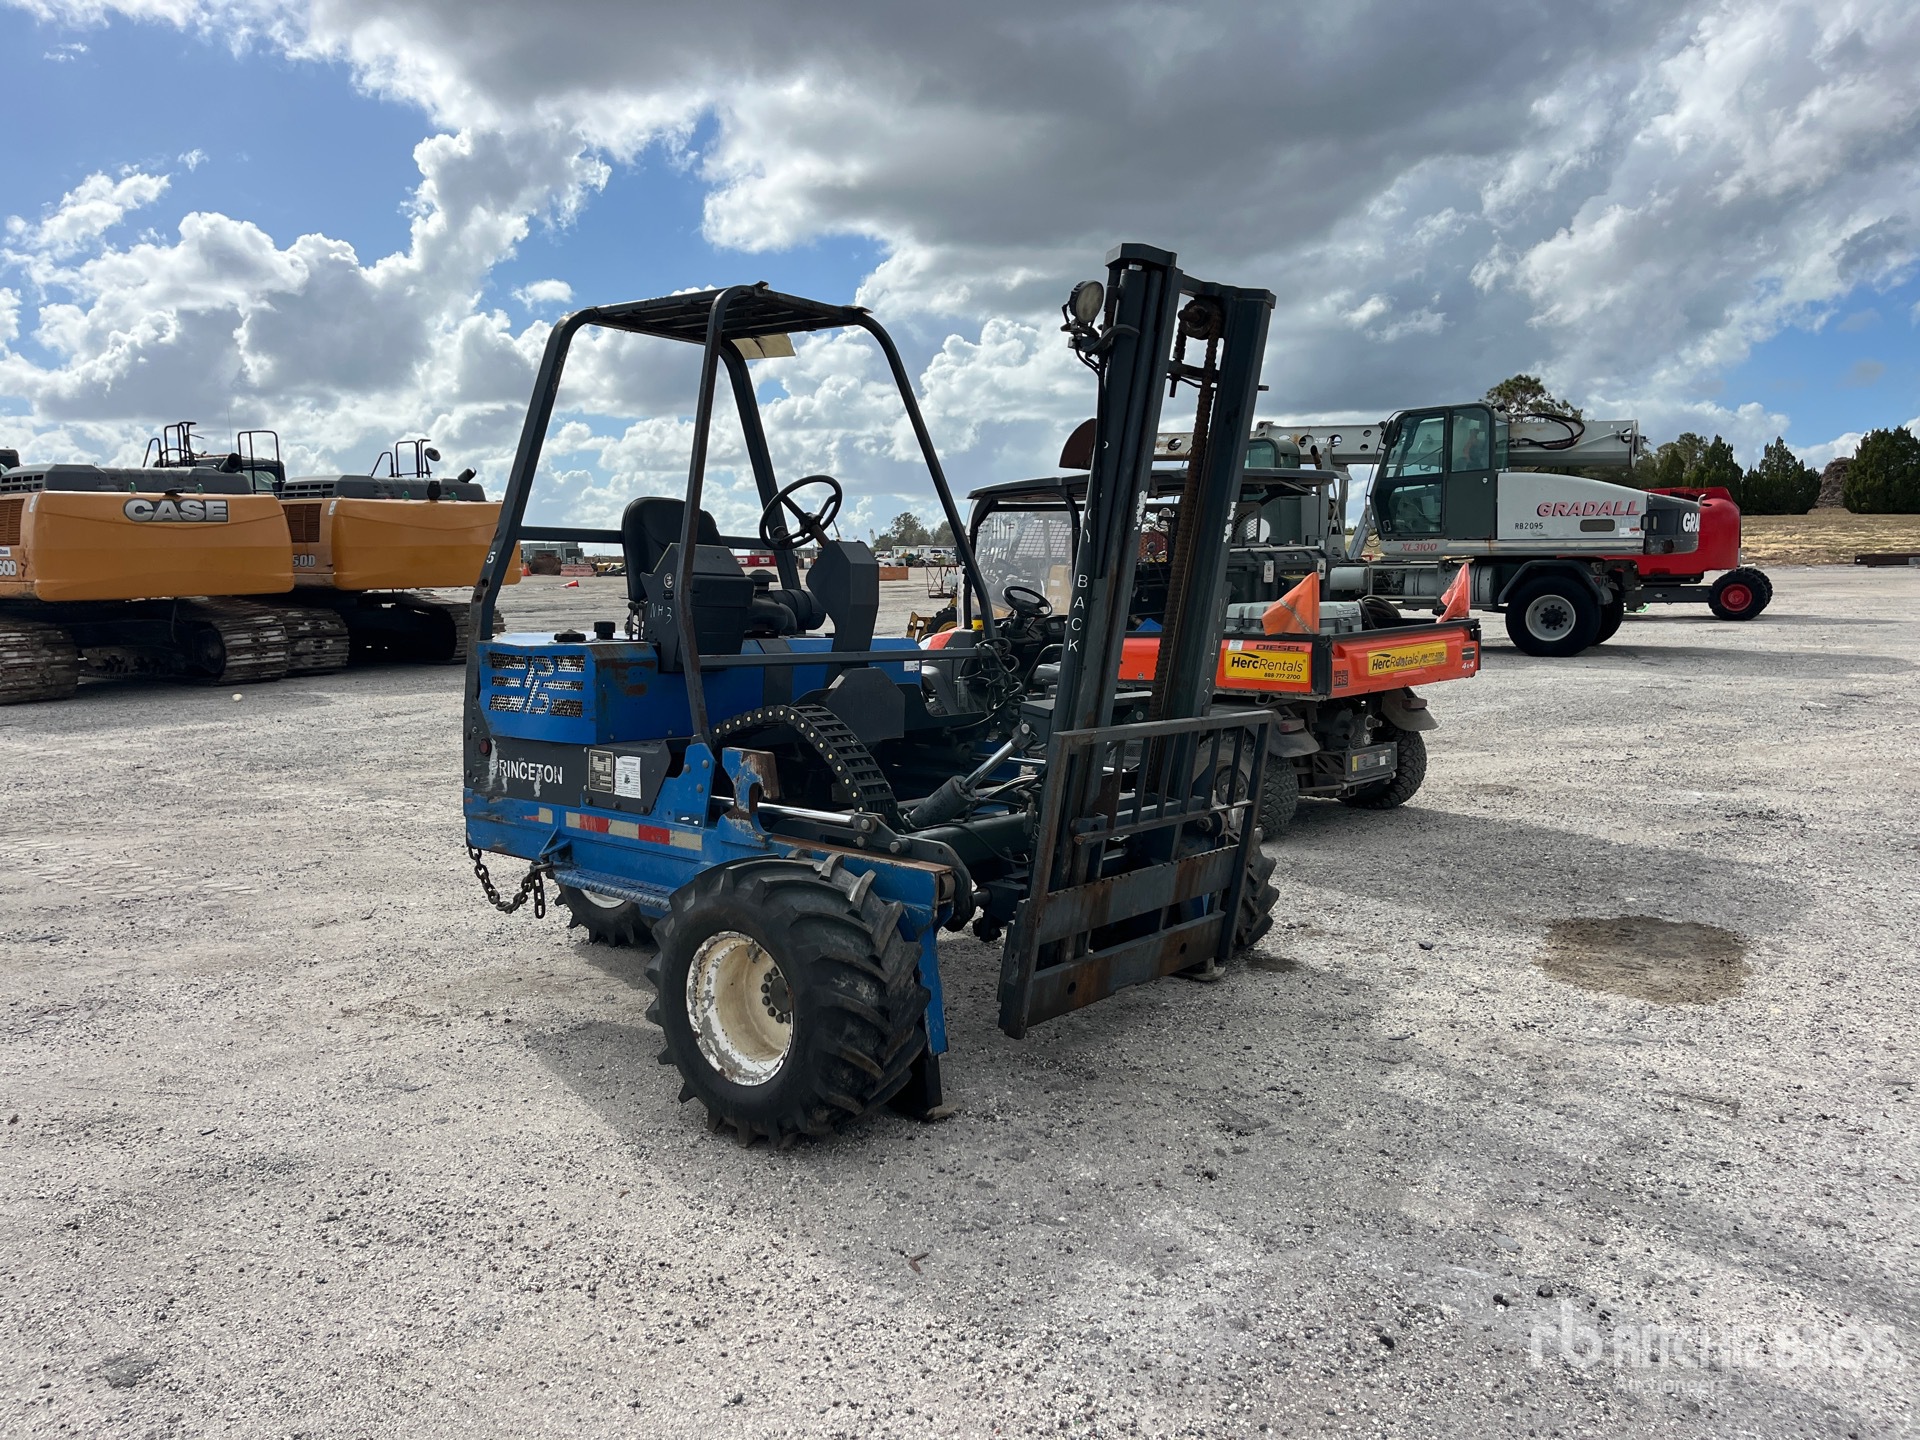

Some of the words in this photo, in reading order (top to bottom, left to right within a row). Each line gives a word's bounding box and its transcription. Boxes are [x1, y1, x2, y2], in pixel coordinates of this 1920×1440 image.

[125, 501, 227, 521] CASE
[1537, 500, 1640, 517] GRADALL
[1515, 522, 1543, 530] RB2095
[1401, 543, 1437, 551] XL3100
[1067, 574, 1088, 653] BACK
[1256, 644, 1304, 652] DIESEL
[1231, 656, 1303, 673] HercRentals
